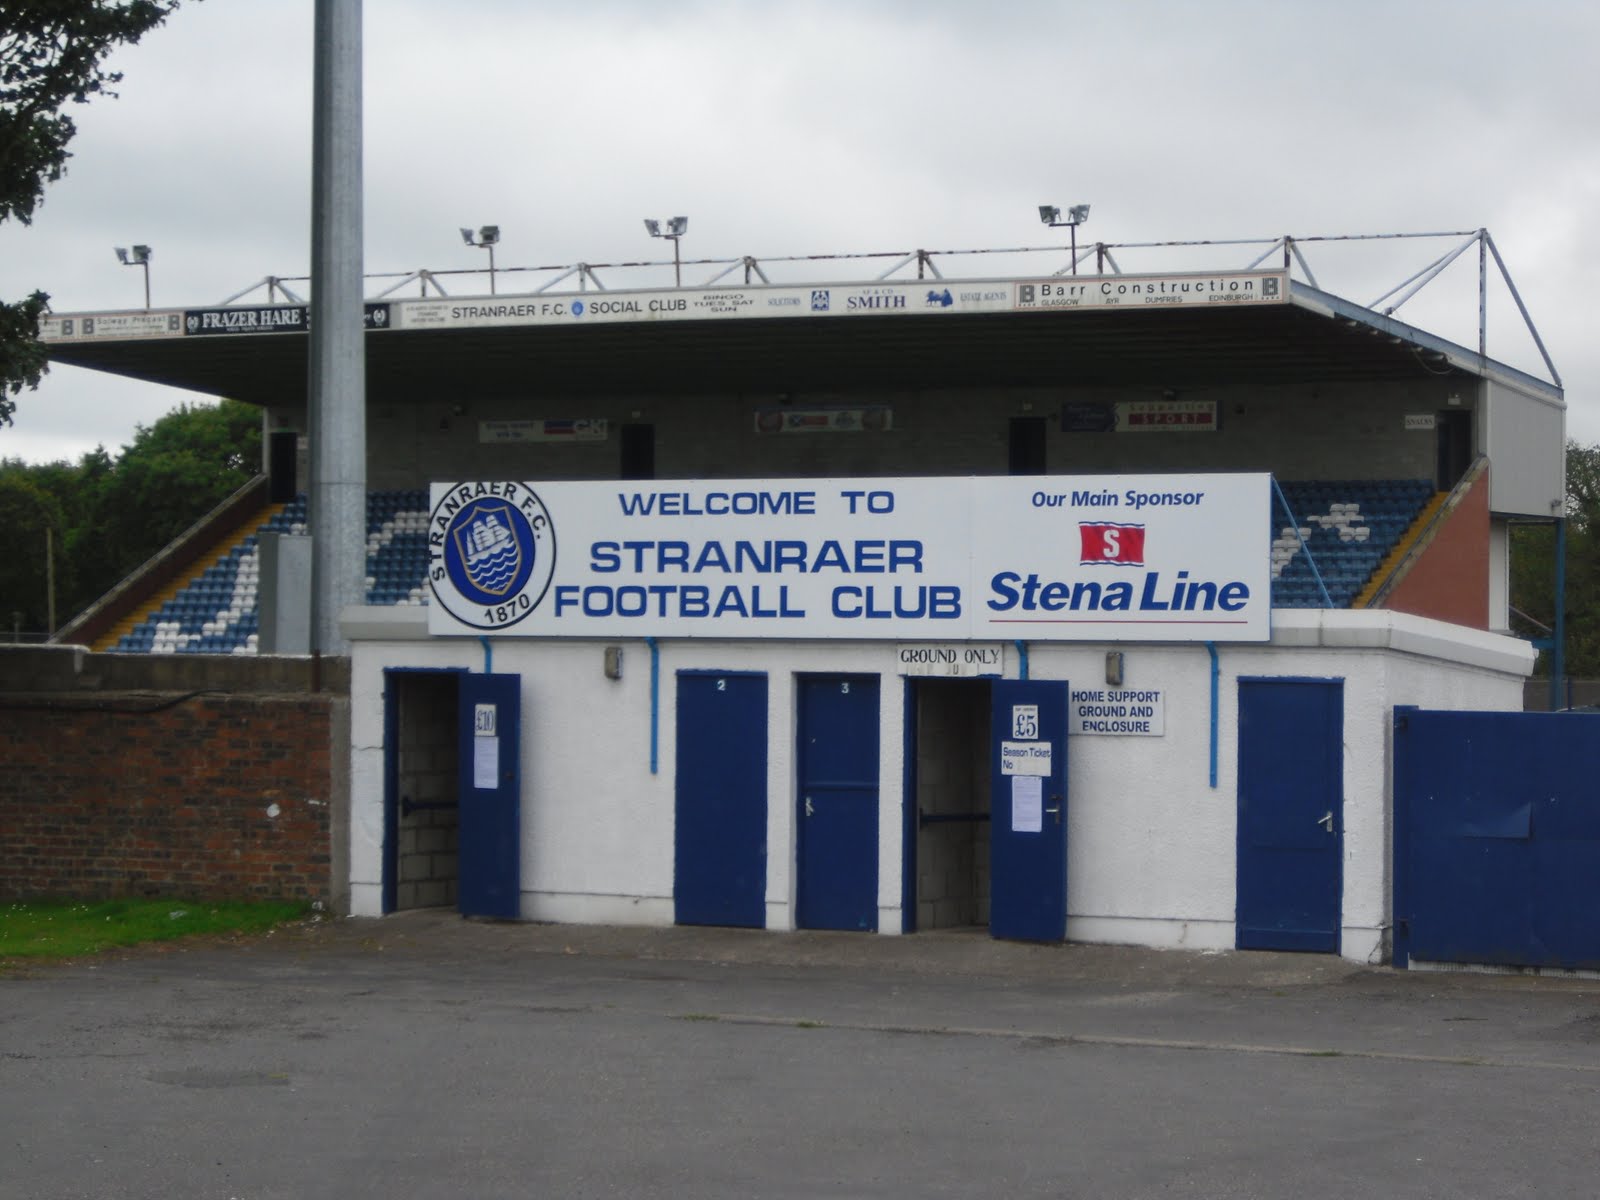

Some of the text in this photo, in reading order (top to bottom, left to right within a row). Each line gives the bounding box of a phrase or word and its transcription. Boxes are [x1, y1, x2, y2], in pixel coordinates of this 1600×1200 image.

[1041, 284, 1086, 296] Barr
[1101, 280, 1254, 295] Construction
[847, 295, 906, 309] SMITH
[1145, 296, 1183, 304] DUMFRIES
[1209, 294, 1253, 302] EDINBURGH
[451, 304, 536, 319] STRANRAER
[541, 303, 567, 316] F.C.
[589, 300, 642, 314] SOCIAL
[648, 299, 687, 312] CLUB
[202, 311, 257, 329] FRAZER
[260, 309, 301, 326] HARE
[1142, 414, 1199, 424] SPORT
[618, 490, 895, 516] WELCOME TO
[1032, 489, 1204, 510] Our Main Sponsor
[431, 481, 547, 581] STRANRAER F.C.
[1103, 529, 1120, 558] S
[589, 540, 923, 574] STRANRAER
[987, 571, 1249, 612] Stena Line
[484, 593, 531, 624] 1870
[554, 585, 962, 619] FOOTBALL CLUB
[900, 649, 999, 664] GROUND ONLY
[717, 680, 726, 691] 2
[841, 683, 850, 694] 3
[1072, 691, 1160, 703] HOME SUPPORT
[1079, 705, 1153, 717] GROUND AND
[476, 711, 494, 731] £10
[1015, 714, 1036, 736] £5
[1082, 721, 1150, 732] ENCLOSURE
[1003, 747, 1051, 758] Season Ticket
[1003, 759, 1013, 769] No
